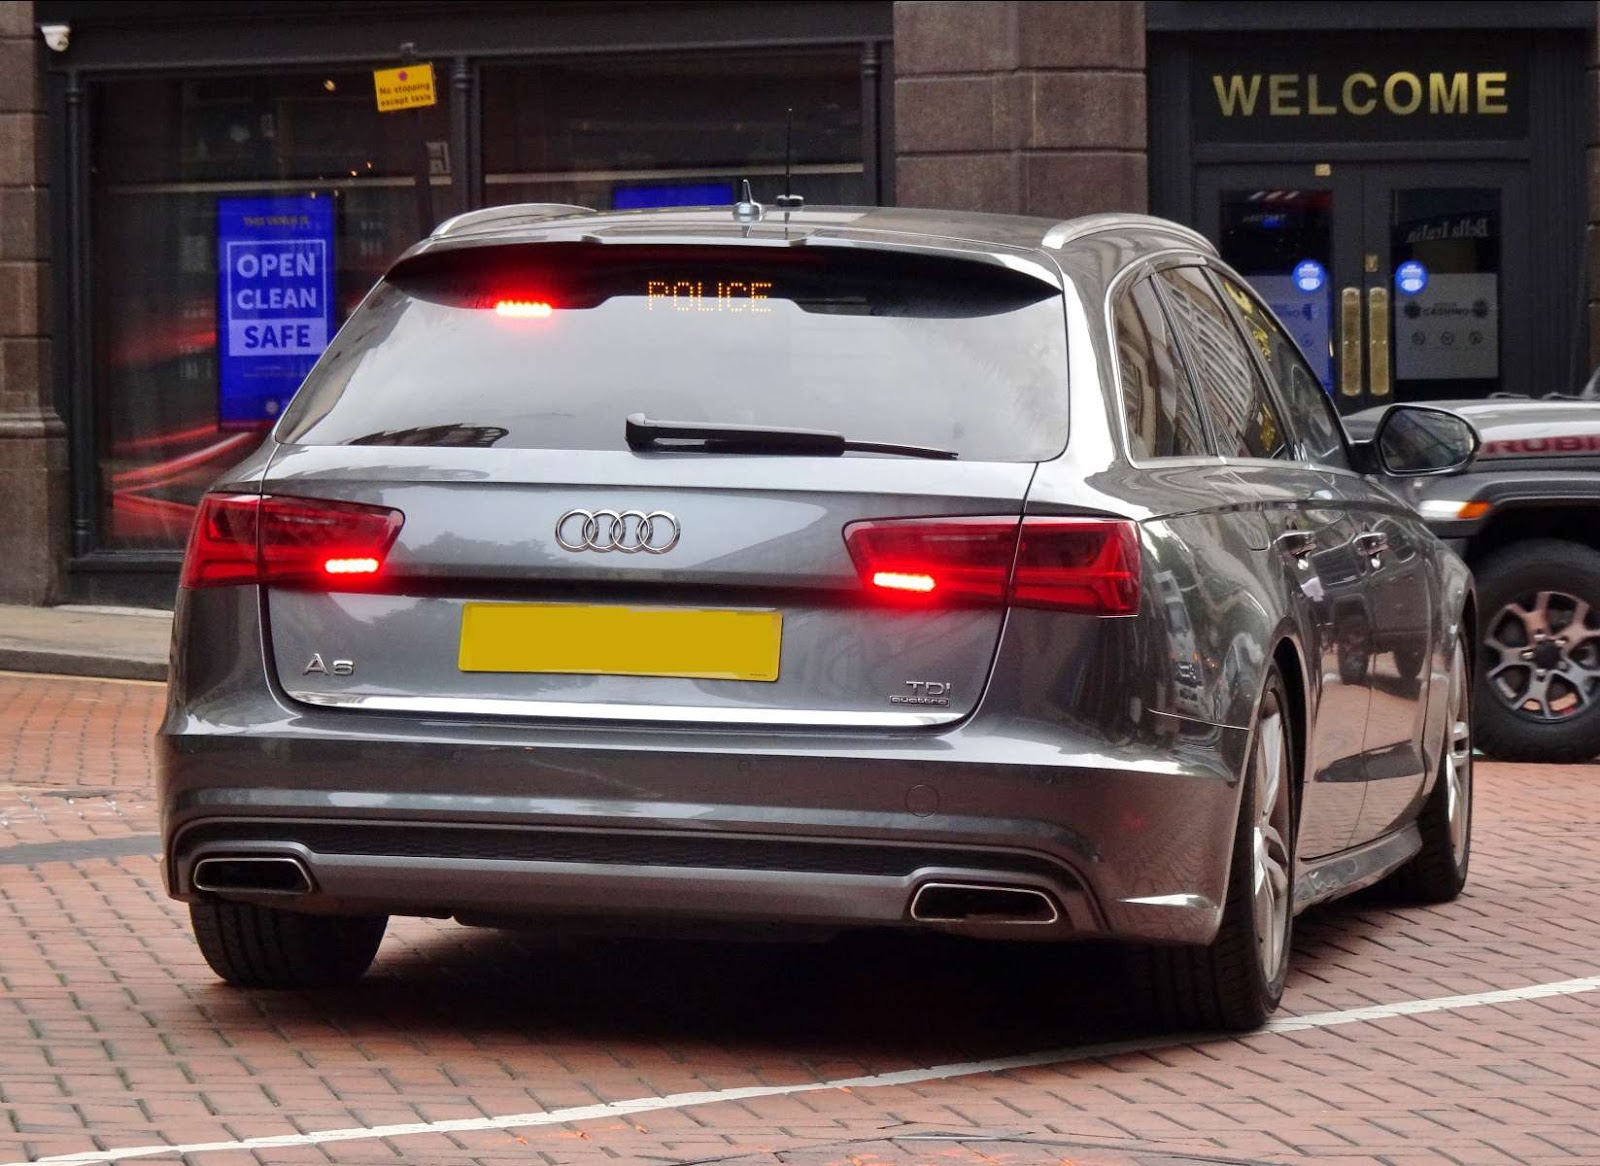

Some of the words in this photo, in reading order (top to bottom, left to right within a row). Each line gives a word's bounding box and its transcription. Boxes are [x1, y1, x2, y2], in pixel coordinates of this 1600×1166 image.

[380, 87, 391, 95] No
[395, 83, 430, 93] stopping
[1212, 71, 1508, 117] WELCOME
[381, 97, 408, 107] except
[237, 253, 315, 278] OPEN
[237, 288, 317, 311] CLEAN
[648, 280, 772, 311] POLICE
[244, 325, 311, 349] SAFE
[303, 652, 355, 676] A6
[906, 680, 951, 695] TDI
[890, 696, 949, 706] quattro
